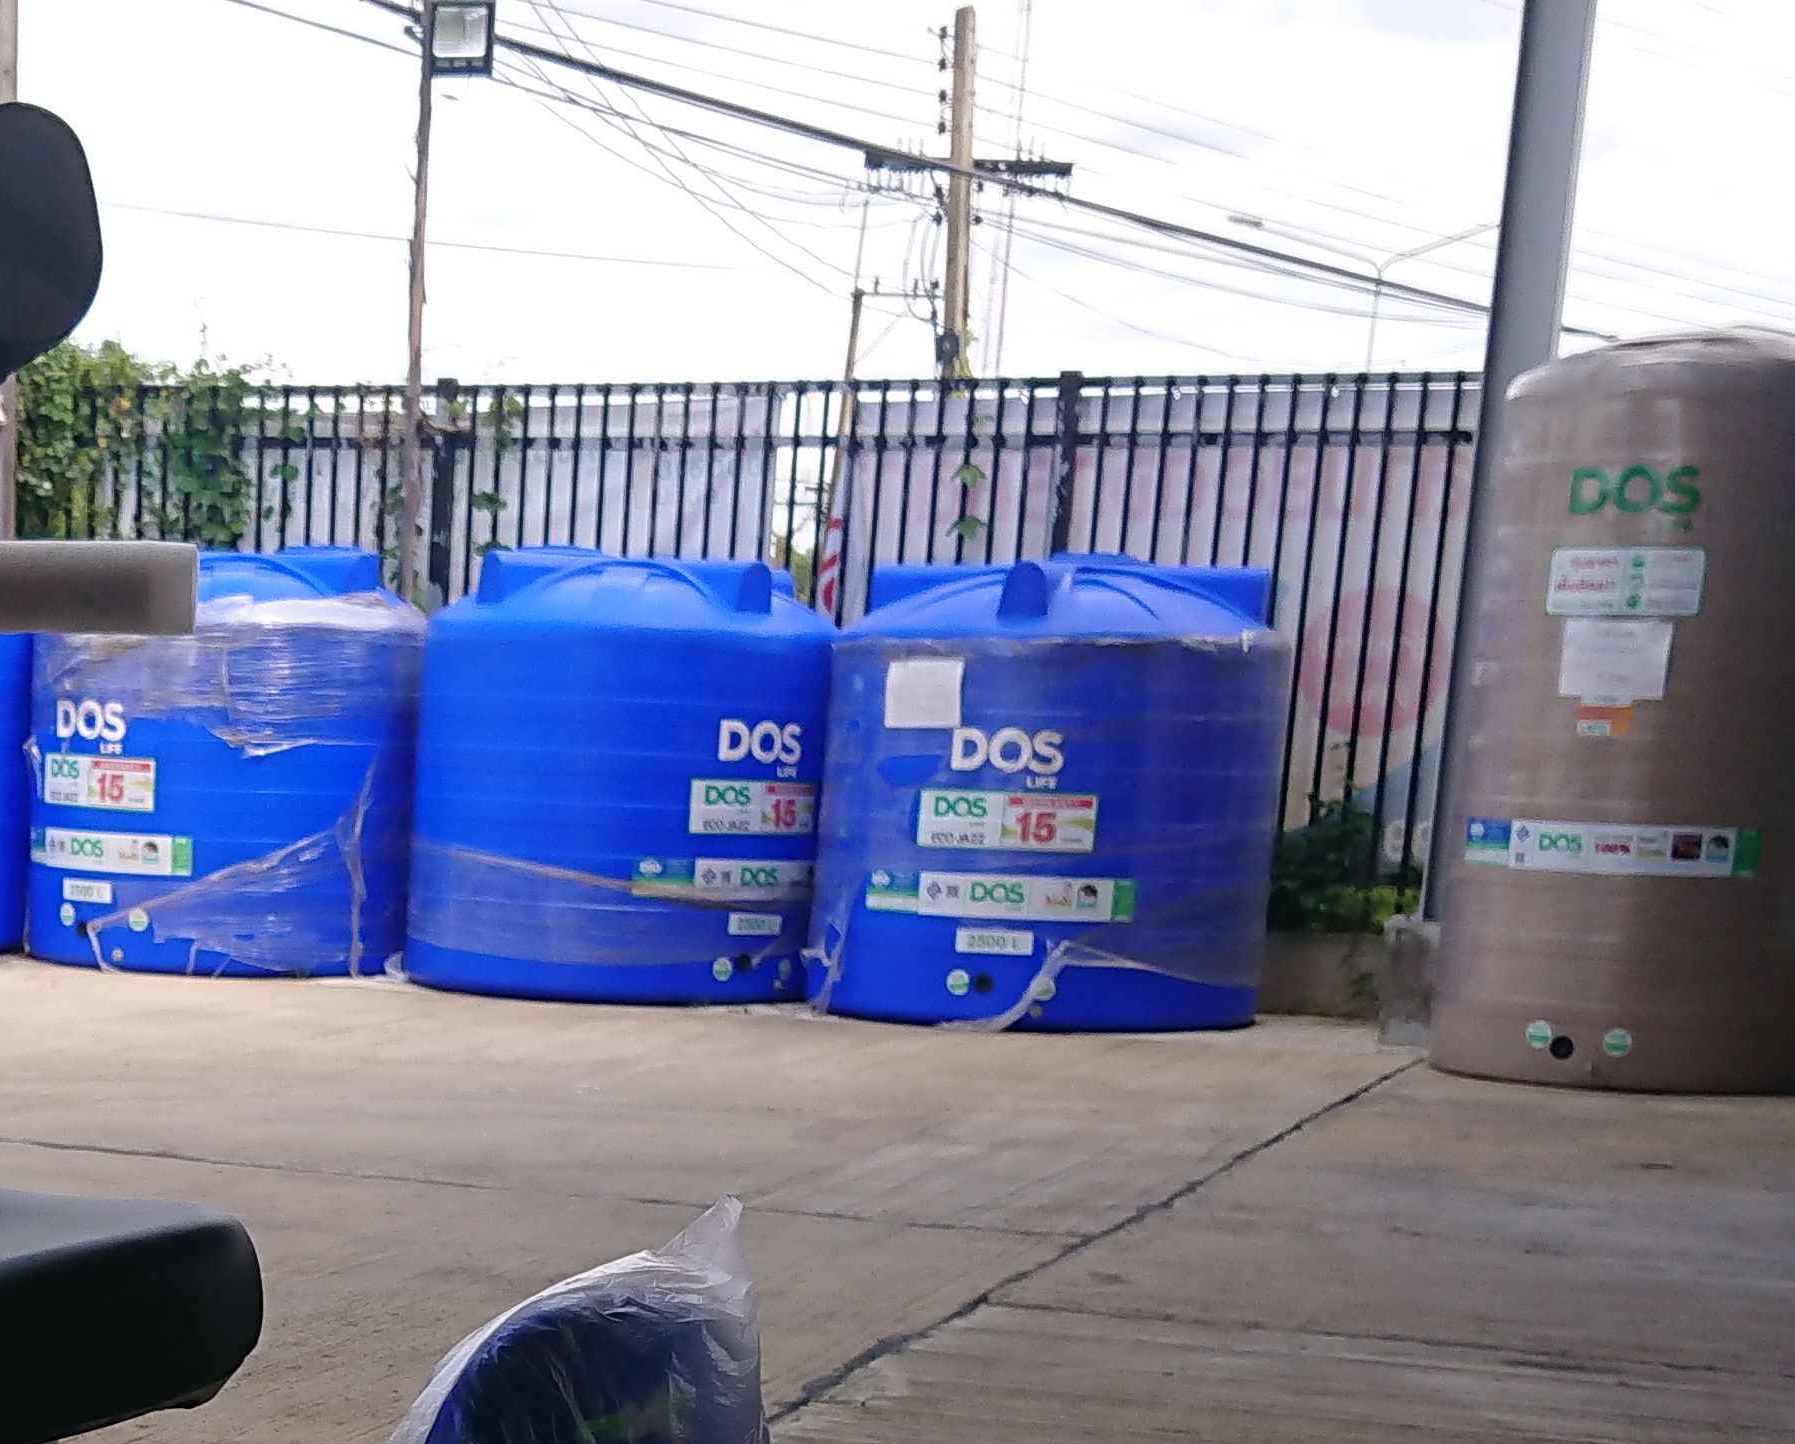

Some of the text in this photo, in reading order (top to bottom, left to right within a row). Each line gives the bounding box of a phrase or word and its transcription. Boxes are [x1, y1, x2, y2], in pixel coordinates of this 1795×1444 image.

[1567, 464, 1701, 516] DOS
[56, 698, 127, 742] DOS
[717, 718, 803, 765] DOS
[950, 727, 1064, 775] DOS
[51, 757, 81, 779] DOS
[98, 772, 125, 804] 15
[704, 784, 752, 806] DOS
[1026, 775, 1058, 791] LIFE
[772, 798, 798, 829] 15
[933, 796, 988, 818] DOS
[1016, 811, 1057, 844] 15
[70, 838, 105, 858] DOS
[740, 867, 779, 887] DOS
[969, 881, 1025, 903] DOS
